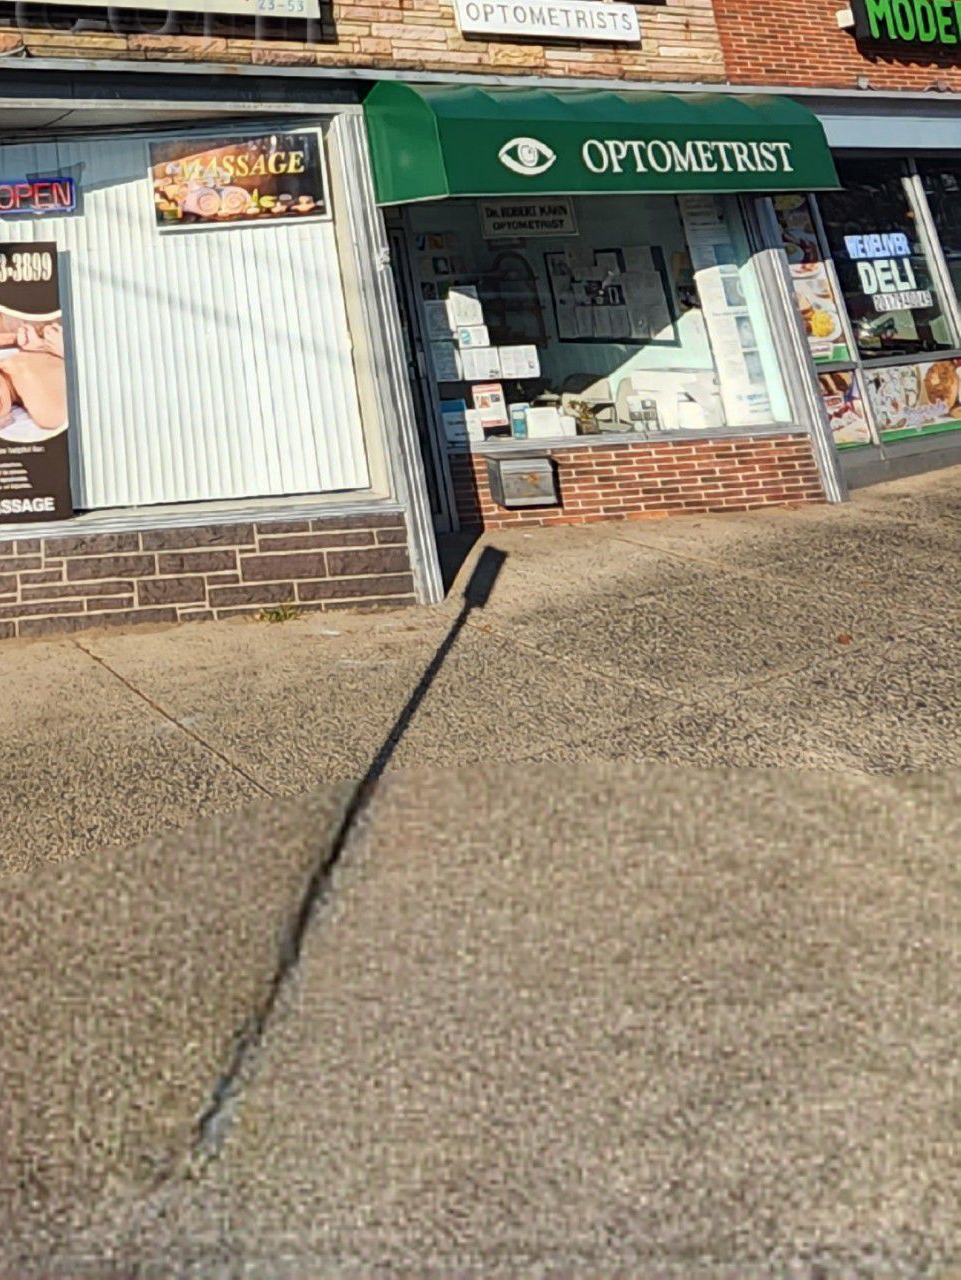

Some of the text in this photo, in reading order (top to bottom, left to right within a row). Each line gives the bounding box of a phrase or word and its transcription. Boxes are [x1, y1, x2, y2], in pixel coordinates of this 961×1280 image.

[257, 0, 305, 13] 23-53
[465, 2, 633, 31] OPTOMETRISTS
[178, 151, 305, 180] MASSAGE
[582, 139, 794, 173] OPTOMETRIST
[857, 258, 917, 294] DELI
